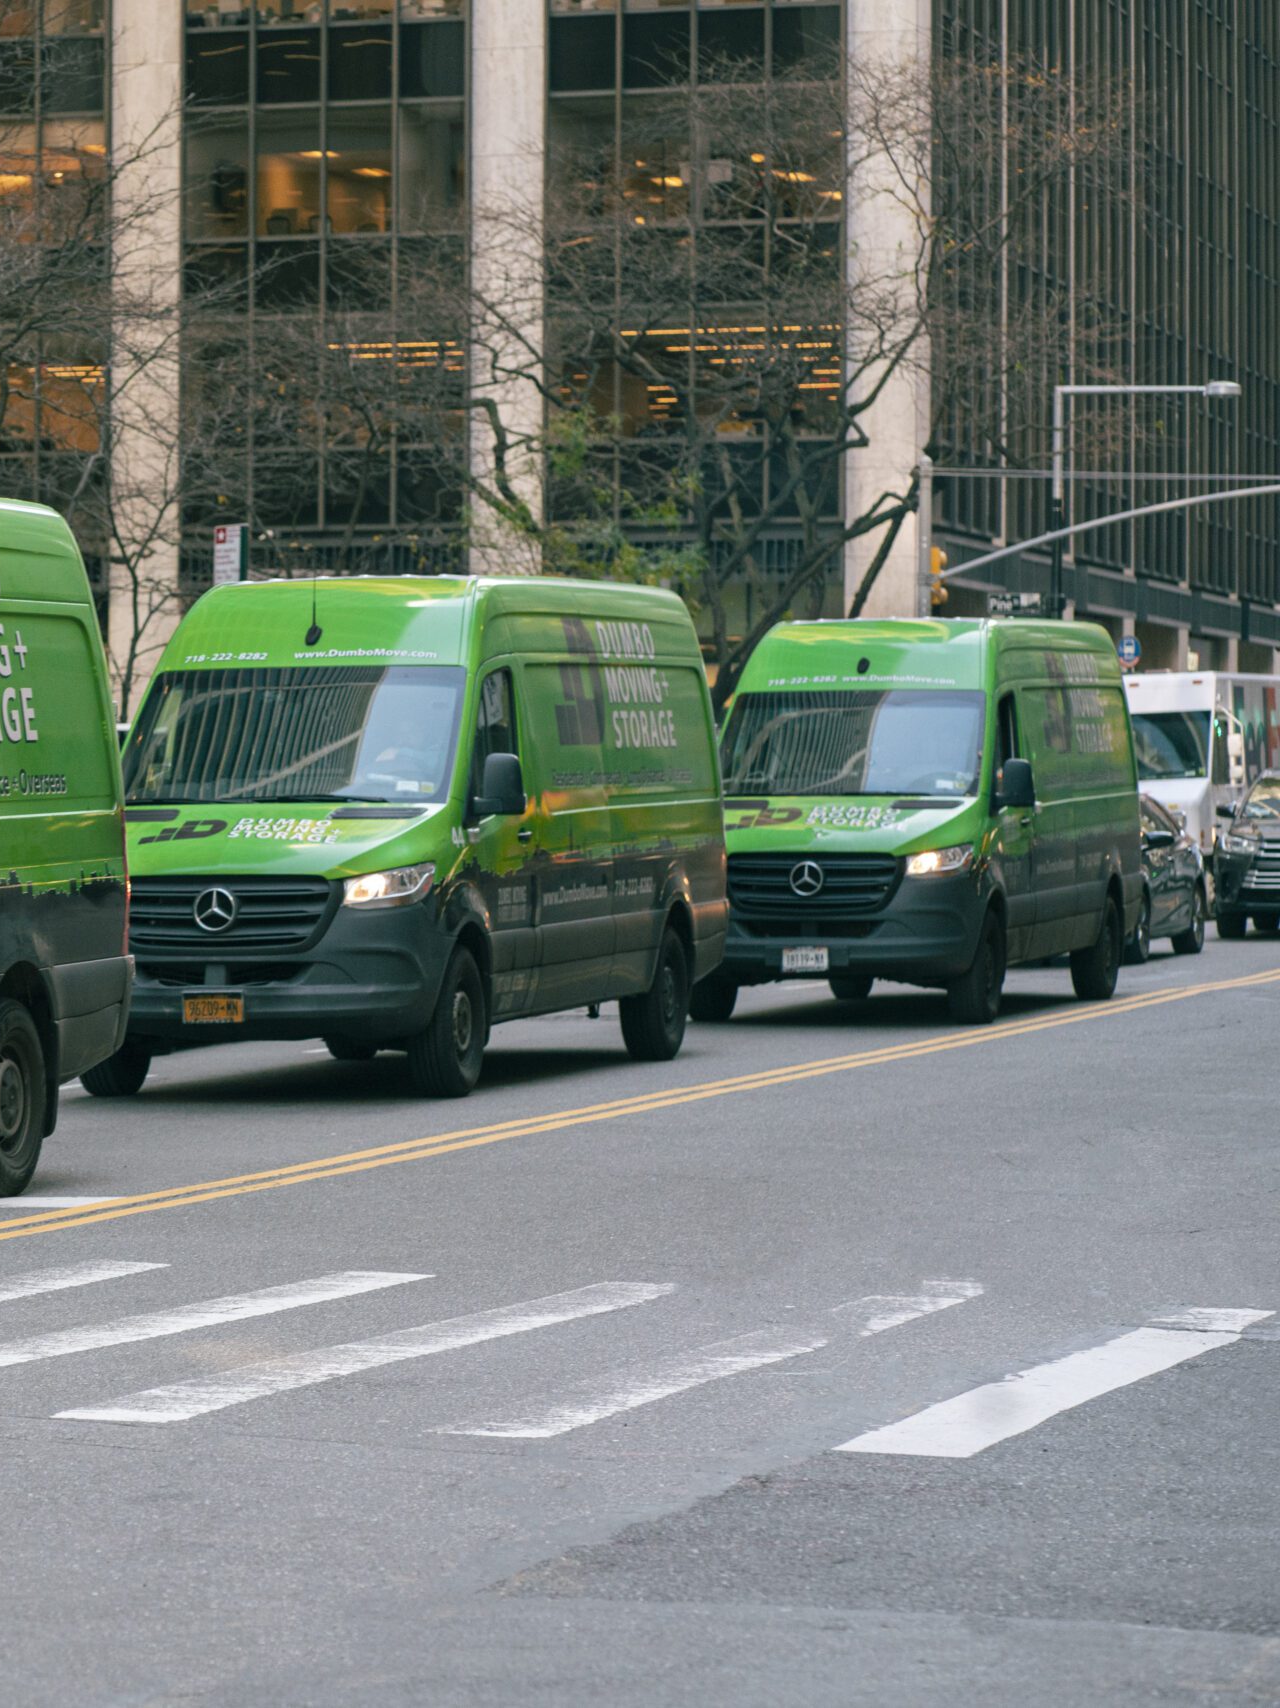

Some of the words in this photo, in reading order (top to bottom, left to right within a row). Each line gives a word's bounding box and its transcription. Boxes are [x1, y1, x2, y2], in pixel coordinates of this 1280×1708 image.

[595, 621, 655, 660] DUMBO
[184, 652, 268, 664] 718-222-8282
[294, 648, 438, 660] www.DumboMove.com
[612, 710, 677, 748] STORAGE
[19, 768, 67, 795] Overseas
[238, 818, 332, 827] DUMBO
[227, 830, 338, 844] STORAGE
[452, 826, 465, 848] 44
